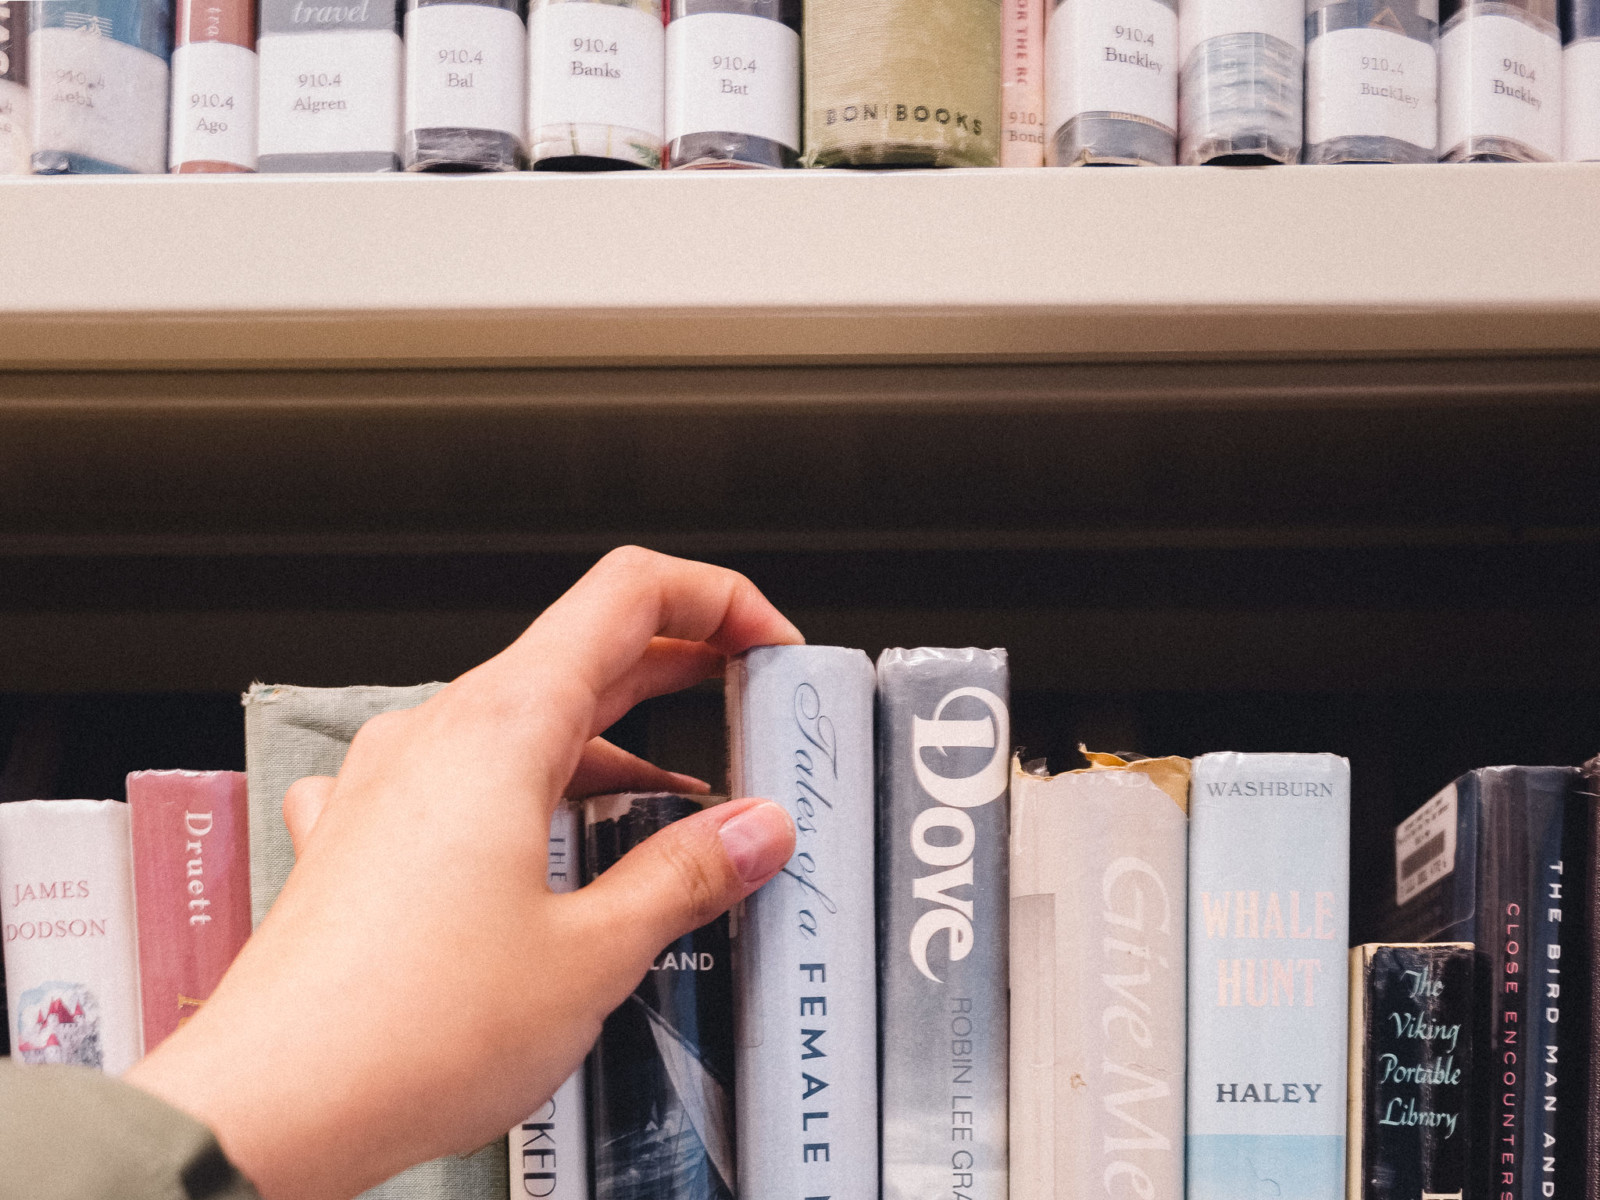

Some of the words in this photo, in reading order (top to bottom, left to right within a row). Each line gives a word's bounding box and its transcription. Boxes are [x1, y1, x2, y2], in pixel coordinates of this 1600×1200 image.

[208, 7, 222, 42] tra
[293, 0, 369, 23] travel
[573, 37, 618, 55] 910.4
[1016, 26, 1028, 59] THE
[1115, 25, 1156, 47] 910.4
[438, 48, 484, 66] 910.4
[571, 60, 622, 79] Banks
[713, 55, 757, 73] 910.4
[1104, 47, 1163, 74] Buckley
[1361, 57, 1405, 75] 910.4
[1503, 58, 1536, 81] 910.4
[298, 73, 342, 88] 910.4
[448, 71, 474, 88] Bal
[721, 78, 749, 95] Bat
[1360, 82, 1420, 109] Buckley
[1493, 79, 1542, 111] Buckley
[191, 93, 235, 110] 910.4
[292, 97, 347, 113] Algren
[196, 117, 228, 134] Ago
[896, 104, 982, 136] BOOKS
[1009, 111, 1044, 126] 910.
[793, 682, 839, 835] Tales
[1206, 781, 1335, 799] WASHBURN
[909, 686, 1010, 985] Dove
[184, 809, 214, 927] Druett
[782, 852, 837, 915] of
[13, 879, 91, 907] JAMES
[1547, 860, 1564, 923] THE
[6, 918, 107, 944] DODSON
[798, 909, 828, 941] a
[1202, 891, 1336, 940] WHALE
[1102, 856, 1171, 1049] Give
[1505, 903, 1520, 994] CLOSE
[1216, 959, 1322, 1007] HUNT
[1401, 968, 1445, 998] The
[1545, 943, 1562, 1024] BIRD
[951, 997, 973, 1083] ROBIN
[1388, 1011, 1461, 1052] Viking
[799, 962, 830, 1164] FEMALE
[1379, 1052, 1461, 1086] Portable
[1543, 1045, 1559, 1112] MAN
[1216, 1083, 1322, 1103] HALEY
[951, 1095, 973, 1142] LEE
[1102, 1059, 1172, 1200] Me
[1379, 1097, 1458, 1139] Library
[1541, 1132, 1557, 1198] AND
